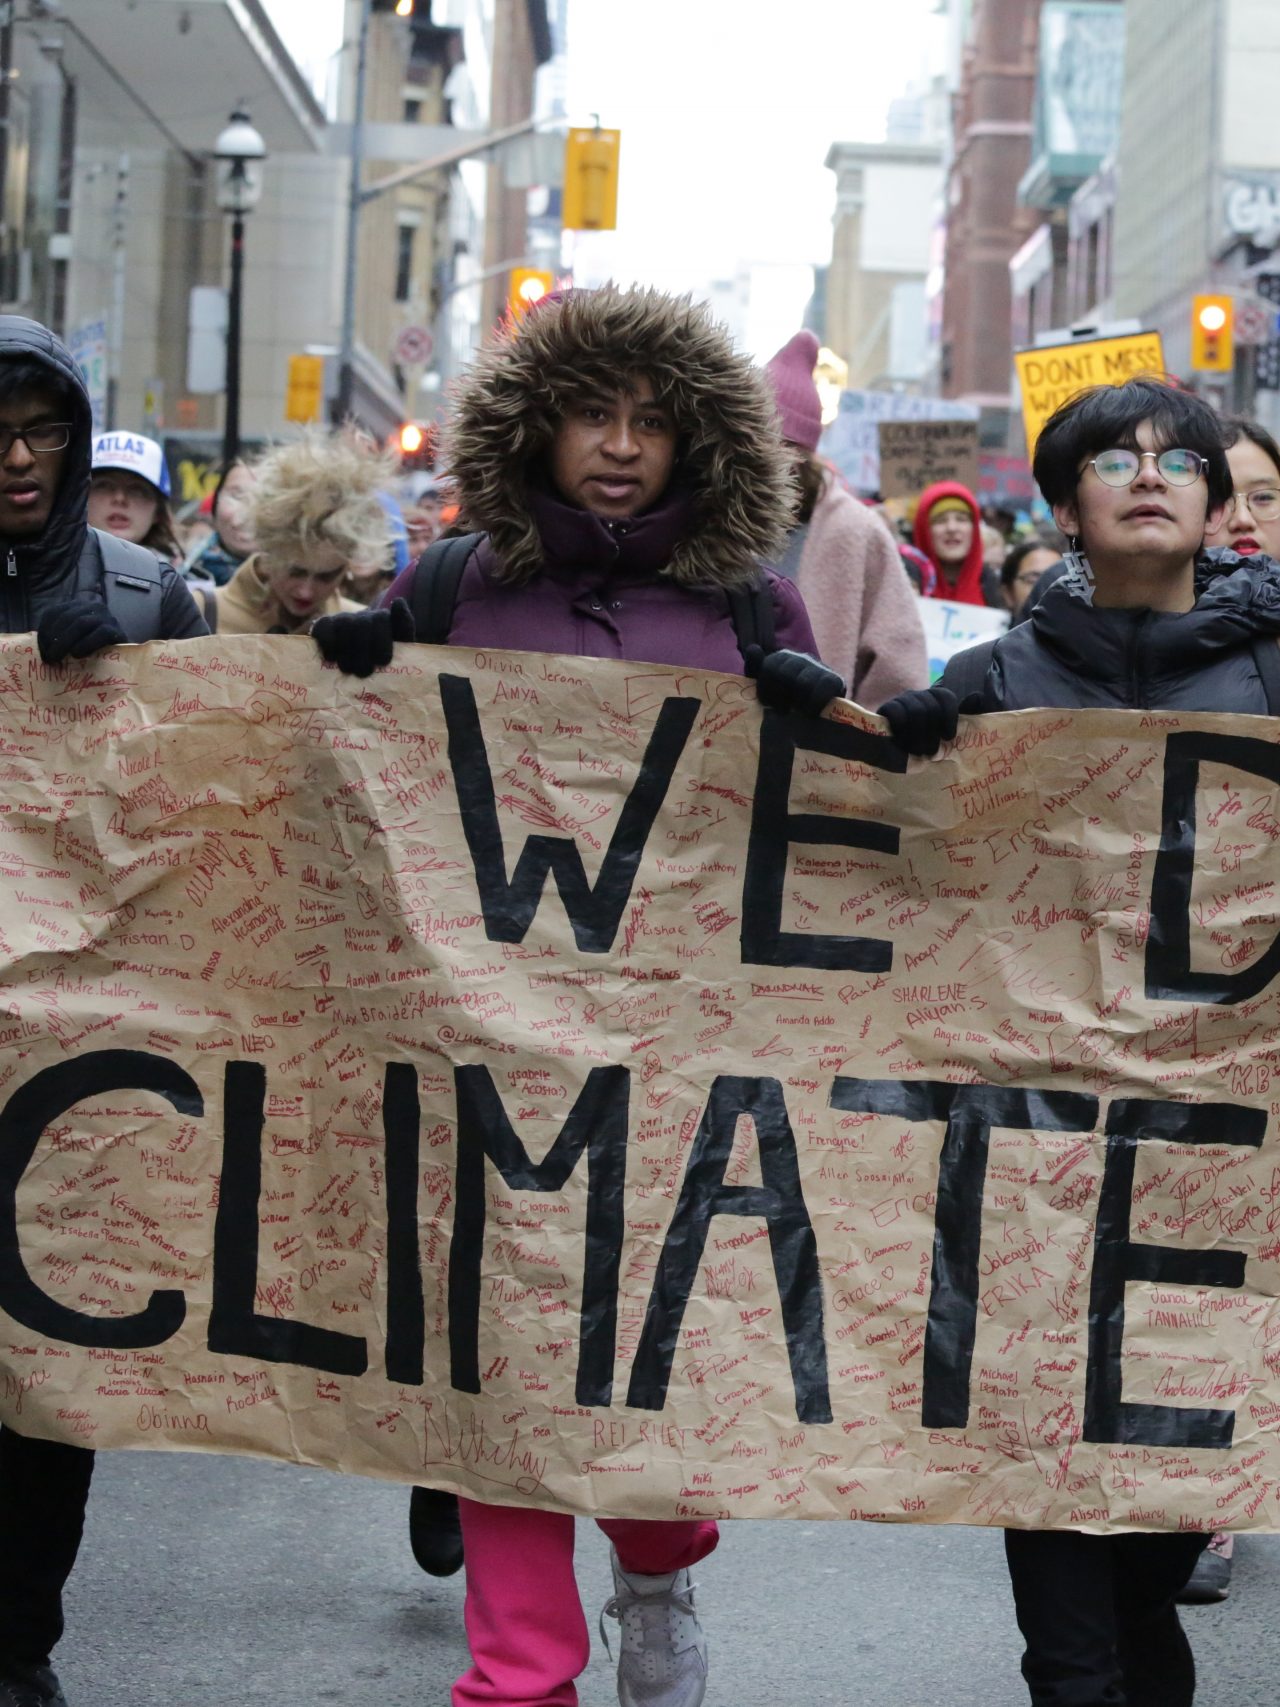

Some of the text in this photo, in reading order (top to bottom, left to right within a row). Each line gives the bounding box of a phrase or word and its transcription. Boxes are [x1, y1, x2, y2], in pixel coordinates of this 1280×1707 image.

[1104, 345, 1159, 377] MESS
[96, 437, 145, 455] ATLAS
[439, 672, 908, 974] WE
[0, 1049, 1267, 1449] CLIMATE
